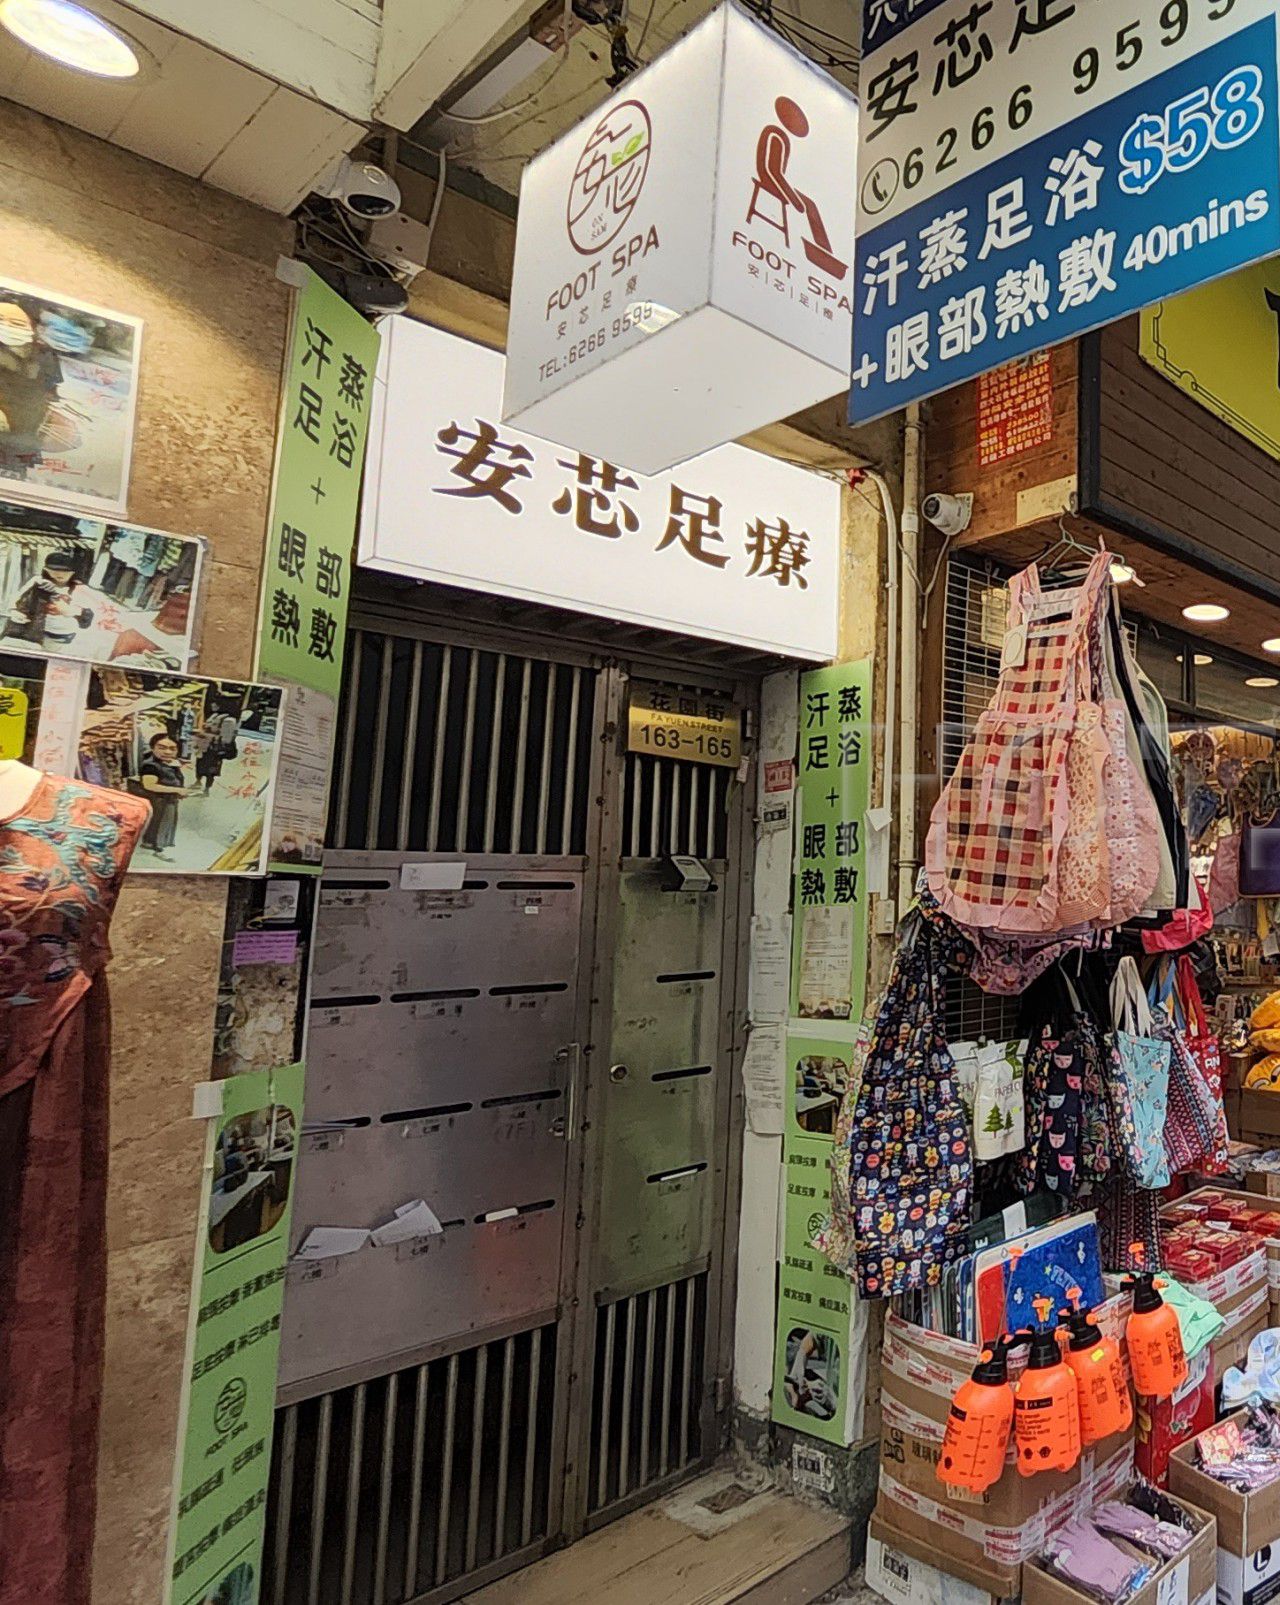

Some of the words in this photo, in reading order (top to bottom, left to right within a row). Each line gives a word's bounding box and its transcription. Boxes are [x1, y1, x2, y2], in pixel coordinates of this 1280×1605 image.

[903, 84, 1034, 190] 6266
[863, 138, 1106, 316] 汗蒸足浴
[1117, 64, 1264, 195] $58
[1122, 188, 1271, 274] 40mins
[546, 260, 602, 321] FOOT
[610, 224, 660, 277] SPA
[732, 230, 797, 279] FOOT
[807, 275, 853, 315] SPA
[431, 418, 813, 591] 安芯足療
[640, 724, 732, 759] 163-165
[650, 692, 726, 722] 花園街
[650, 713, 664, 722] FA
